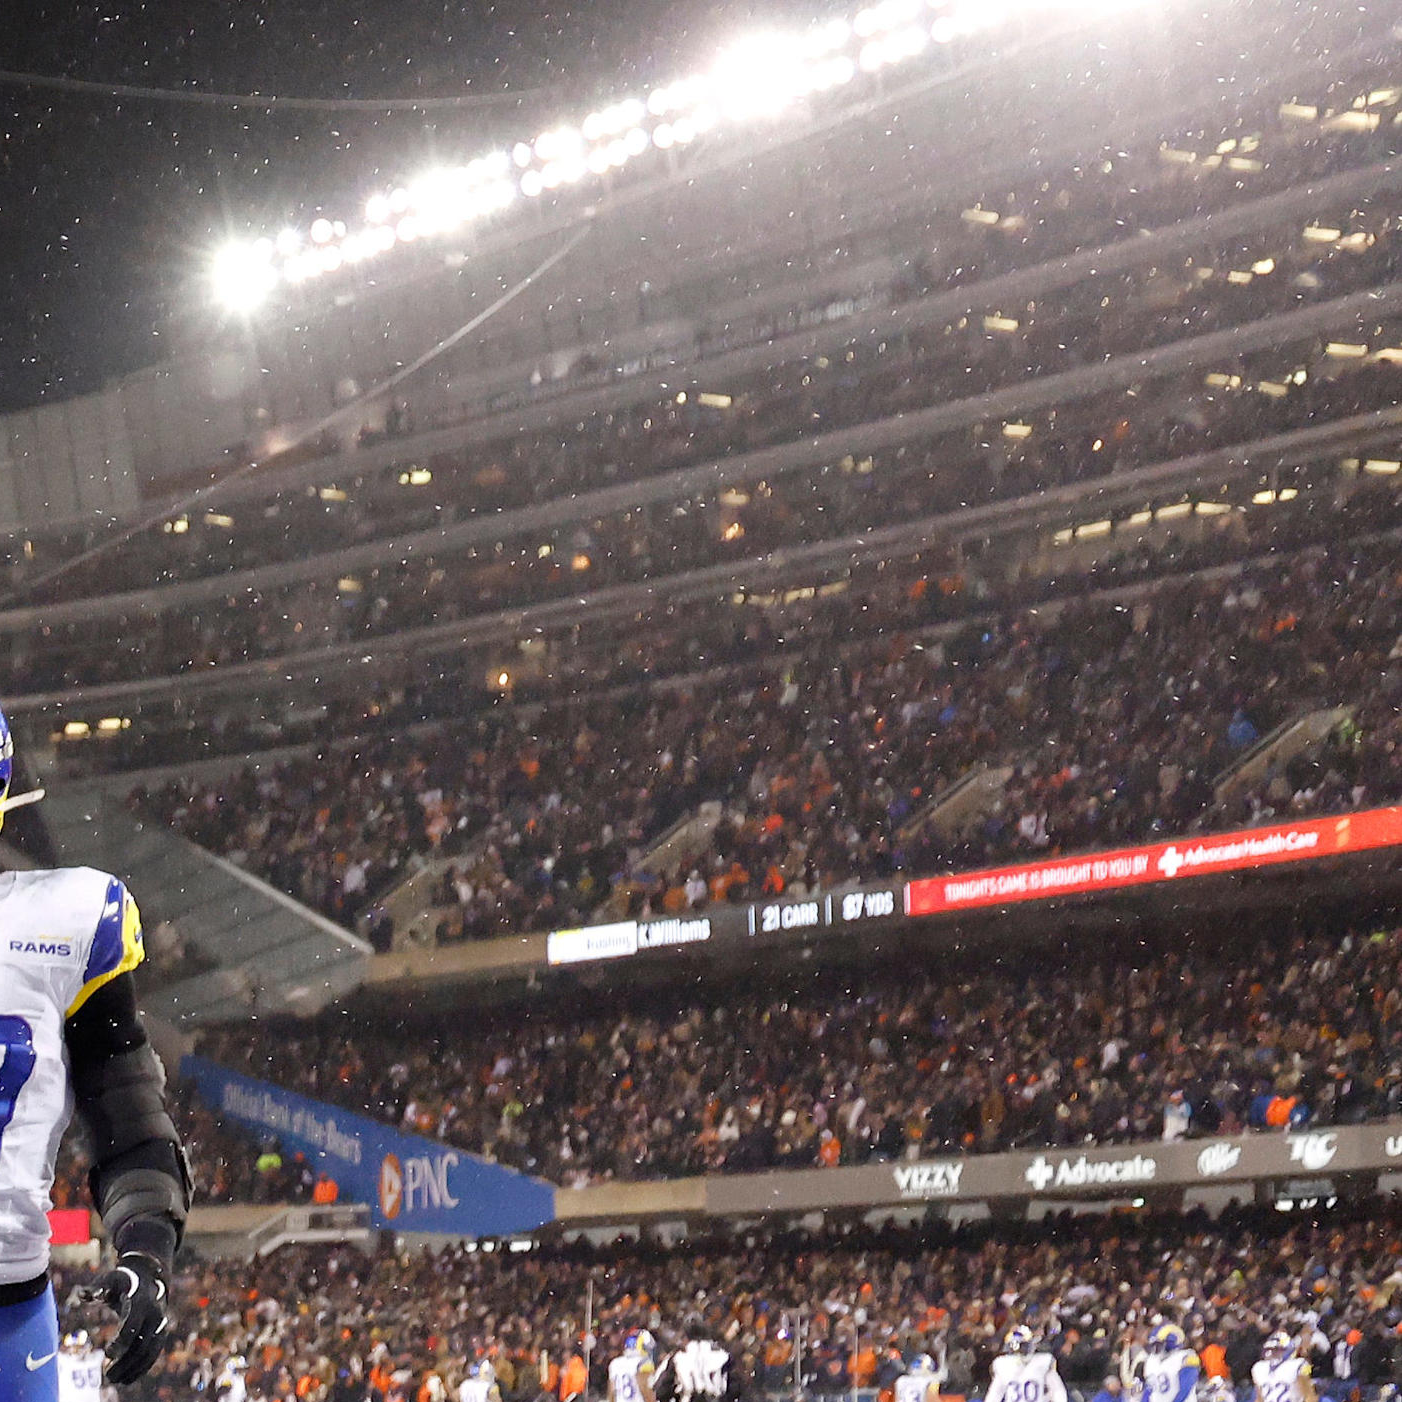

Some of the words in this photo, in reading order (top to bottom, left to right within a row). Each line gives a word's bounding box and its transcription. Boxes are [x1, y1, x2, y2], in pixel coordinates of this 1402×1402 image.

[997, 872, 1028, 895] GAME
[1042, 862, 1091, 888] BROUGHT
[1092, 861, 1108, 880] TO
[1108, 857, 1131, 878] YOU
[1132, 854, 1148, 875] BY
[1184, 839, 1246, 865] Advocate
[1245, 834, 1286, 857] Health
[1285, 831, 1318, 849] Care
[762, 905, 780, 931] 21
[781, 902, 818, 928] CARR
[9, 940, 71, 957] RAMS
[404, 1152, 460, 1213] PNC
[894, 1162, 964, 1190] VIZZY
[1055, 1154, 1156, 1187] Advocate
